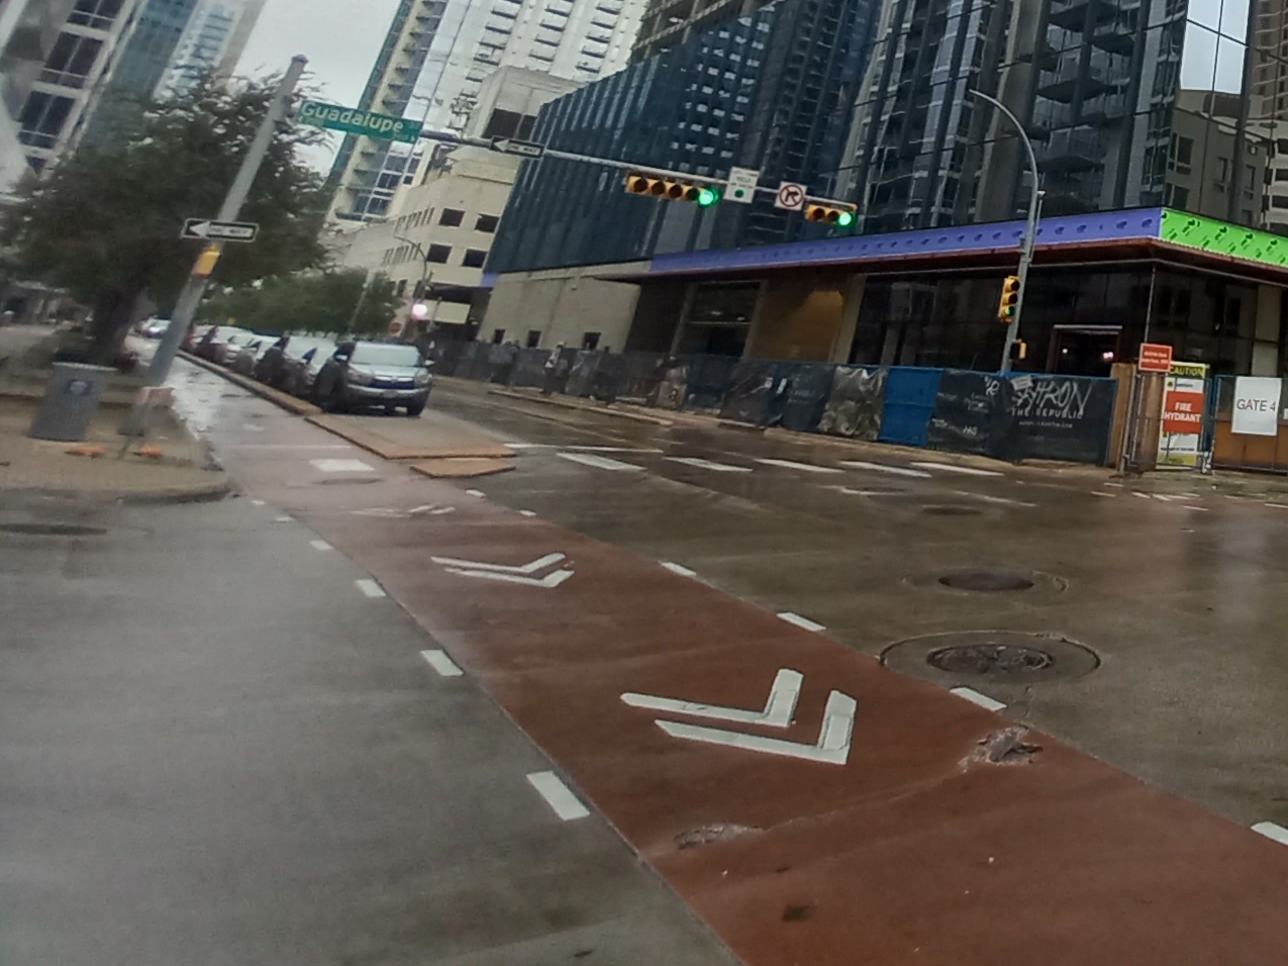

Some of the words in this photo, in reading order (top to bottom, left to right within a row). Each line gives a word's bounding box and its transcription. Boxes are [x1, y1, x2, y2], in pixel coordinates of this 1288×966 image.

[300, 101, 404, 134] Guadalupe
[1169, 365, 1204, 378] CAUTION
[1174, 401, 1193, 412] FIRE
[1236, 398, 1268, 412] GATE
[1270, 401, 1277, 412] 4
[1011, 407, 1029, 417] THE
[1035, 408, 1084, 420] REPUBLIC
[1164, 412, 1202, 423] HYDRANT
